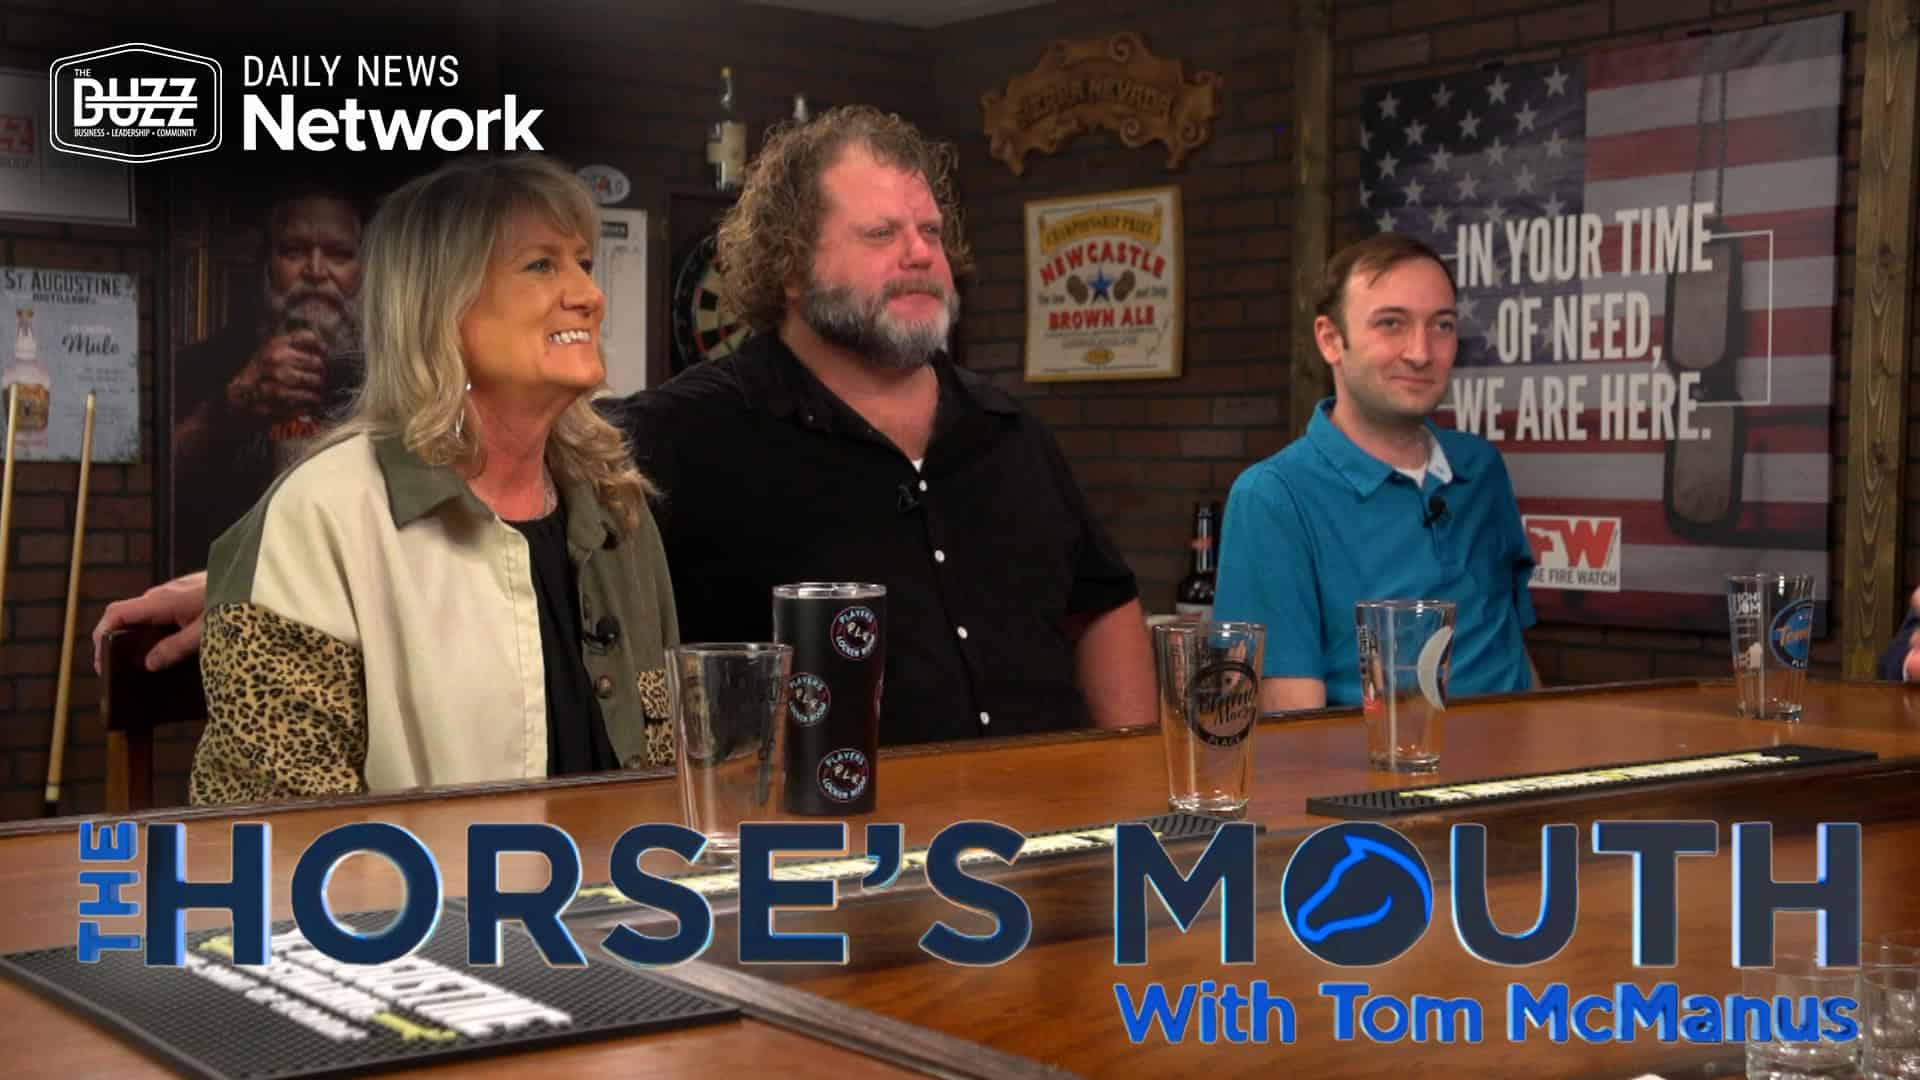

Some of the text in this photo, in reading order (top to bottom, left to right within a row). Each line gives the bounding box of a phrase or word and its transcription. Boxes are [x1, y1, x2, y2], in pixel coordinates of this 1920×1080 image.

[1039, 240, 1166, 286] NEWCASTLE
[1455, 201, 1716, 289] IN YOUR TIME
[31, 270, 122, 298] AUGUSTINE
[1047, 304, 1156, 331] BROWN ALE
[1496, 290, 1663, 370] OF NEED,
[61, 333, 121, 356] Mule
[1452, 371, 1712, 442] WE ARE HERE.
[1577, 570, 1618, 586] WATCH
